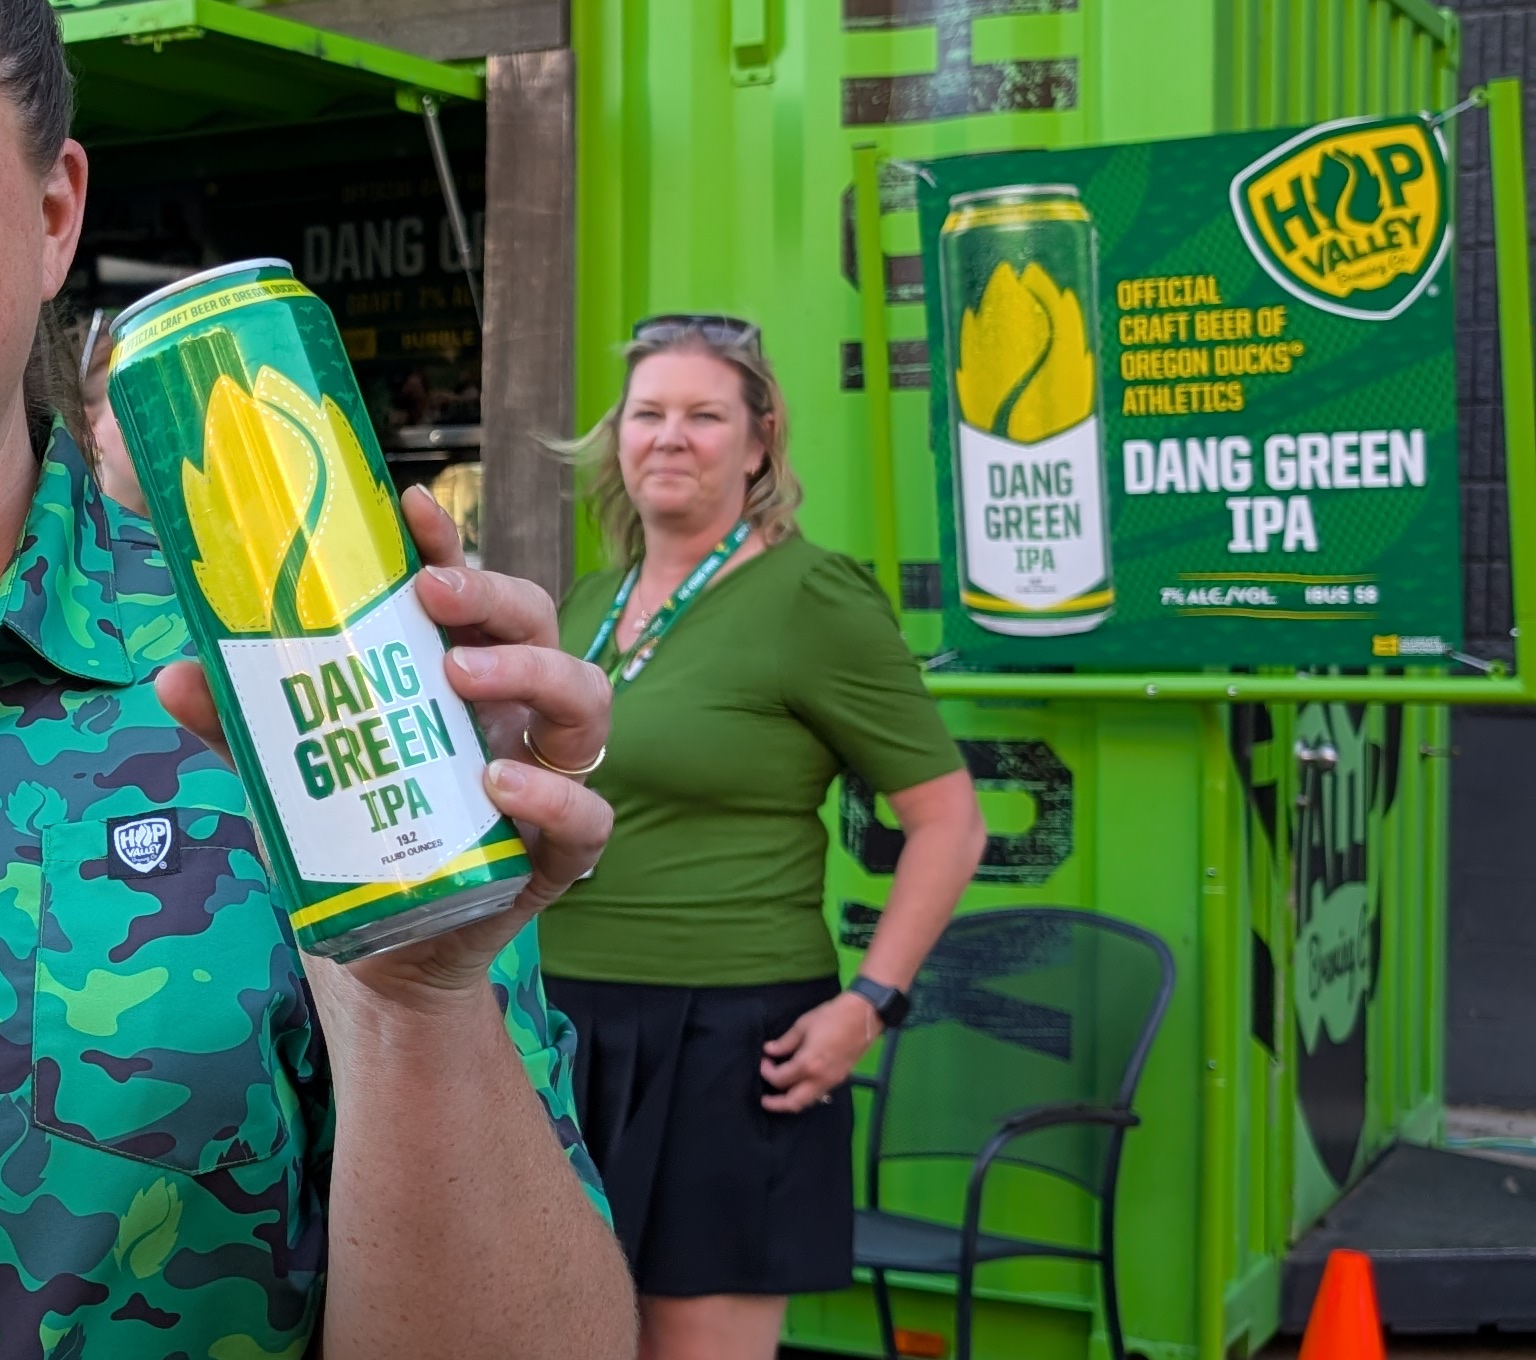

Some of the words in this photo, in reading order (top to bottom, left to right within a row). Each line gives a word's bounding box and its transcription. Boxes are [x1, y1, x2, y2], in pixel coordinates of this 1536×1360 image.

[1261, 143, 1424, 255] HOP
[303, 216, 425, 285] DANG
[1301, 215, 1421, 278] VALLEY
[160, 311, 188, 332] CRAFT
[191, 301, 218, 318] BEER
[219, 295, 233, 308] OF
[233, 286, 270, 304] OREGON
[1117, 274, 1223, 310] OFFICIAL
[1119, 311, 1191, 346] CRAFT
[1194, 308, 1253, 341] BEER
[1257, 305, 1288, 337] OF
[1121, 347, 1210, 381] OREGON
[1122, 380, 1245, 416] ATHLETICS
[988, 460, 1073, 499] DANG
[1122, 436, 1252, 494] DANG
[1264, 428, 1426, 490] GREEN
[984, 502, 1082, 540] GREEN
[1225, 495, 1318, 553] IPA
[1015, 547, 1056, 573] IPA
[280, 640, 421, 736] DANG
[293, 699, 456, 801] GREEN
[359, 777, 433, 833] IPA
[120, 824, 166, 849] HOP
[126, 844, 161, 857] VALLEY
[381, 846, 406, 865] FLUID
[407, 839, 443, 857] OUNCES
